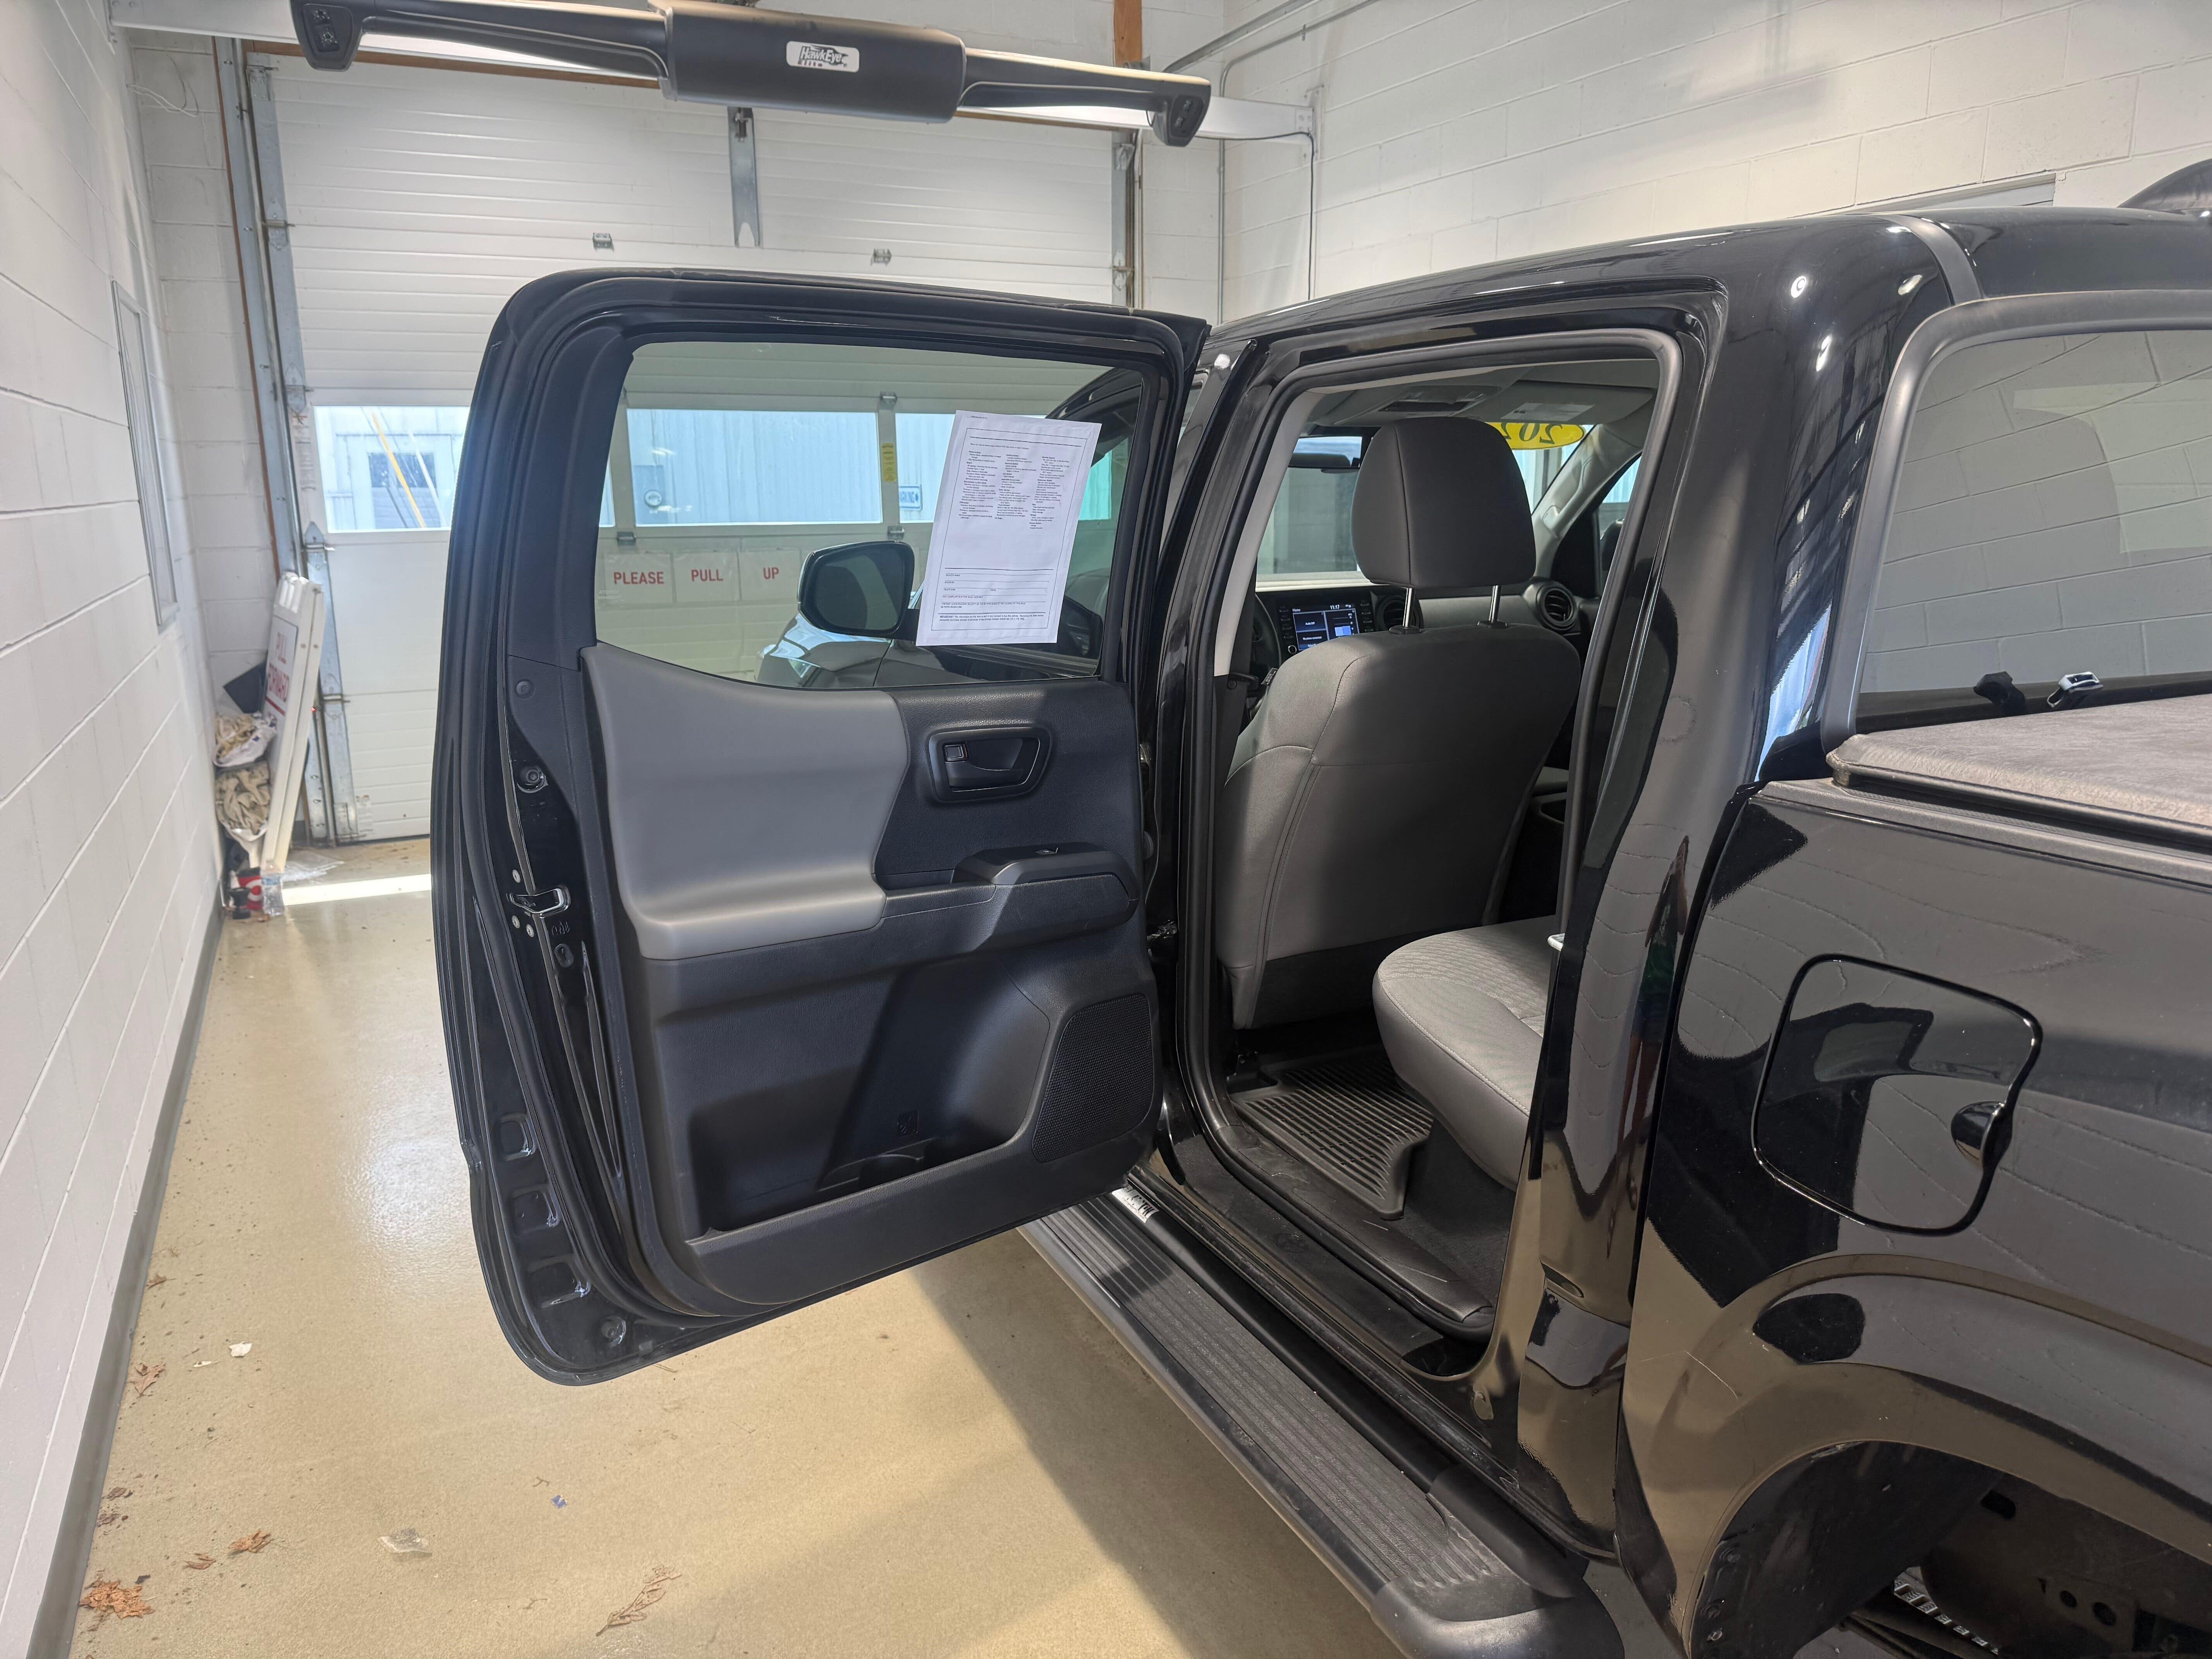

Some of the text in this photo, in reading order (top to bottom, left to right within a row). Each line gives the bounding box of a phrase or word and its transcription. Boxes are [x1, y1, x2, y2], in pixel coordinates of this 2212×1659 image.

[800, 46, 843, 64] HawkEye
[613, 567, 779, 584] PLEASE PULL UP
